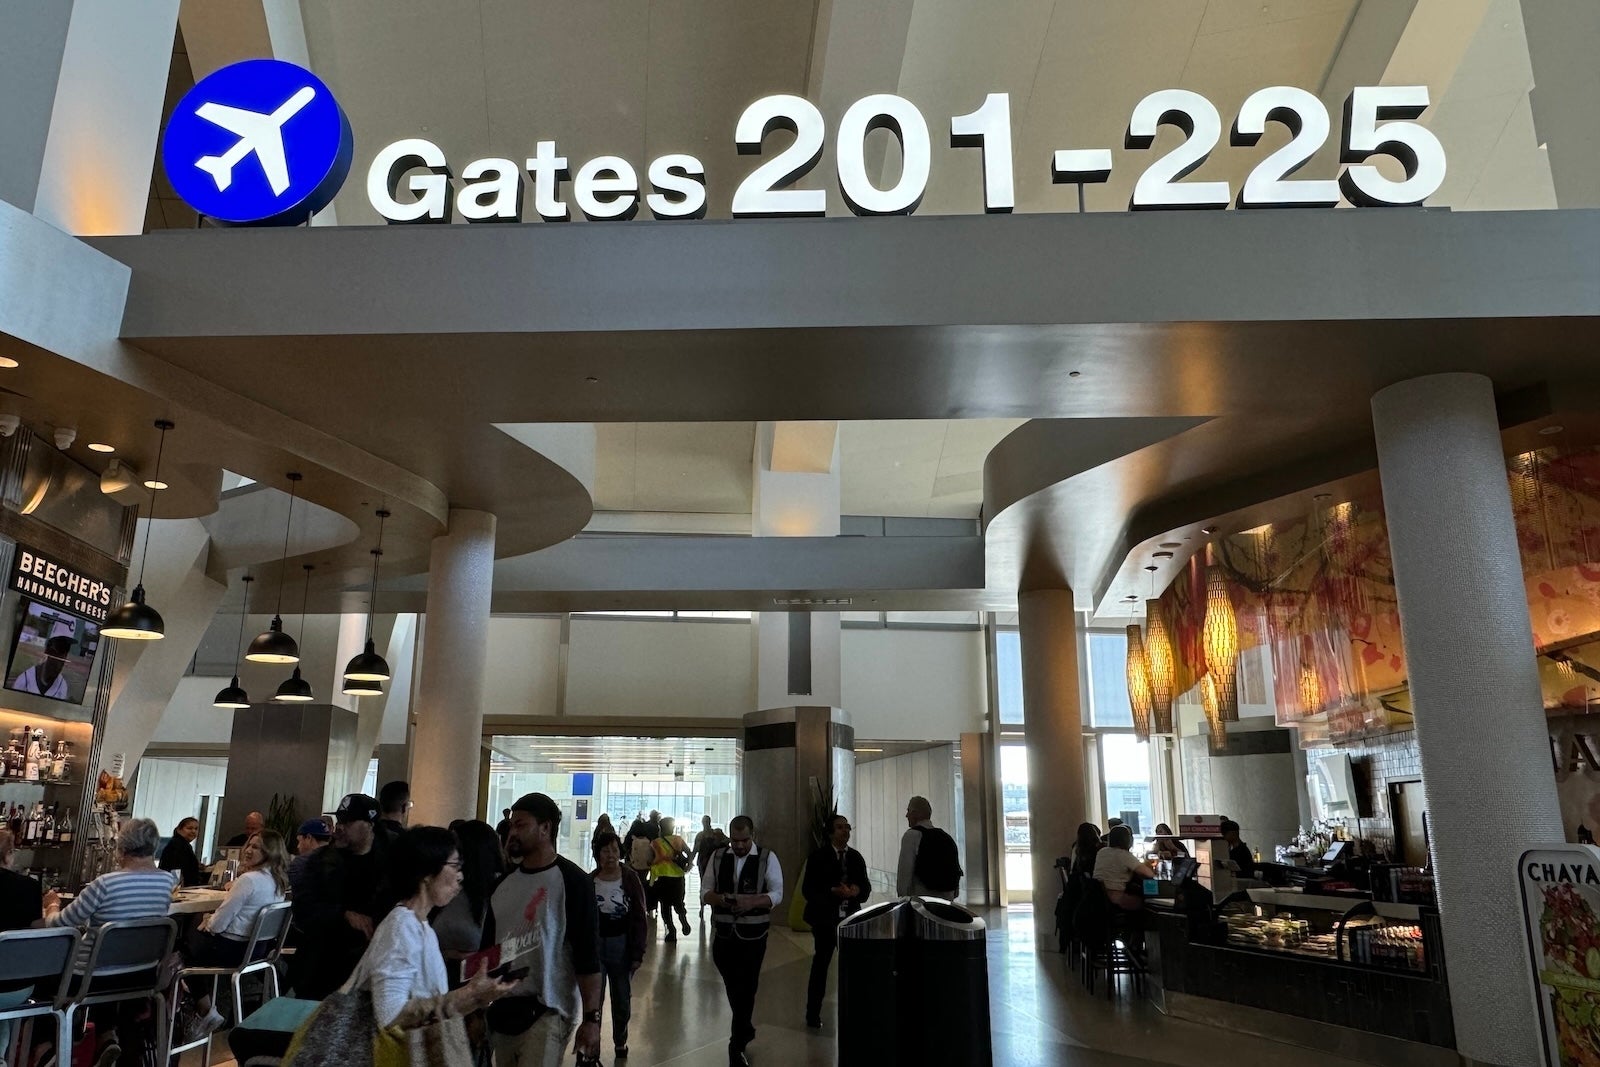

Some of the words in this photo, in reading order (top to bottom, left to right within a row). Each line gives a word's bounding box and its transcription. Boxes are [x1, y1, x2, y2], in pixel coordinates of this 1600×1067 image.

[367, 138, 708, 222] Gates
[16, 576, 71, 607] HANDMADE
[74, 599, 107, 621] CHEESE
[19, 551, 111, 606] BEECHER'S
[1527, 862, 1600, 885] CHAYA
